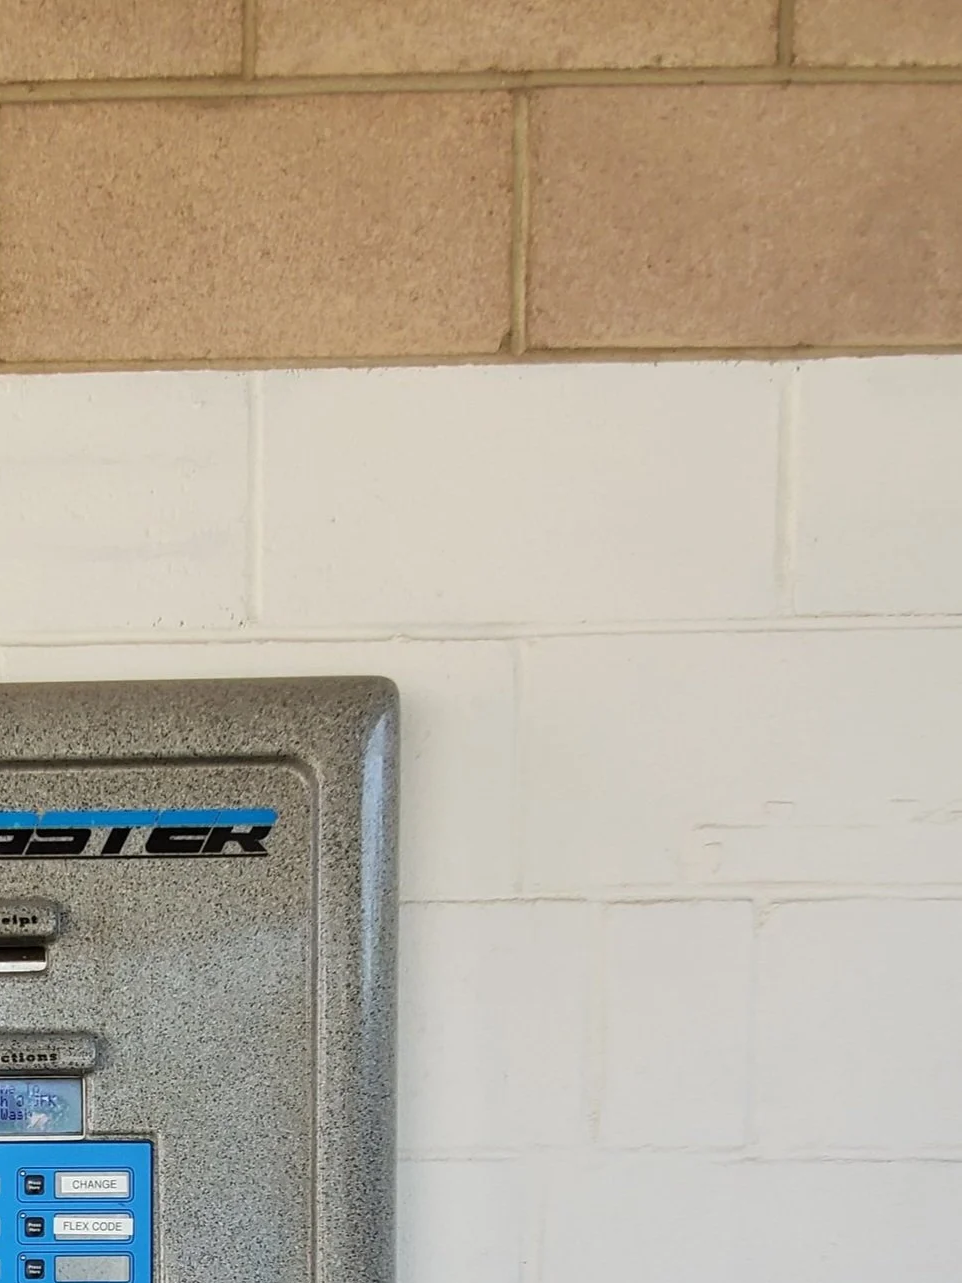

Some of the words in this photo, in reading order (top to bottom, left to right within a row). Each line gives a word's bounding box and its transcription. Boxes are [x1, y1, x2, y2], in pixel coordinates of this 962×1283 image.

[72, 1180, 117, 1189] CHANGE
[63, 1222, 90, 1231] FLEX
[92, 1221, 122, 1232] CODE
